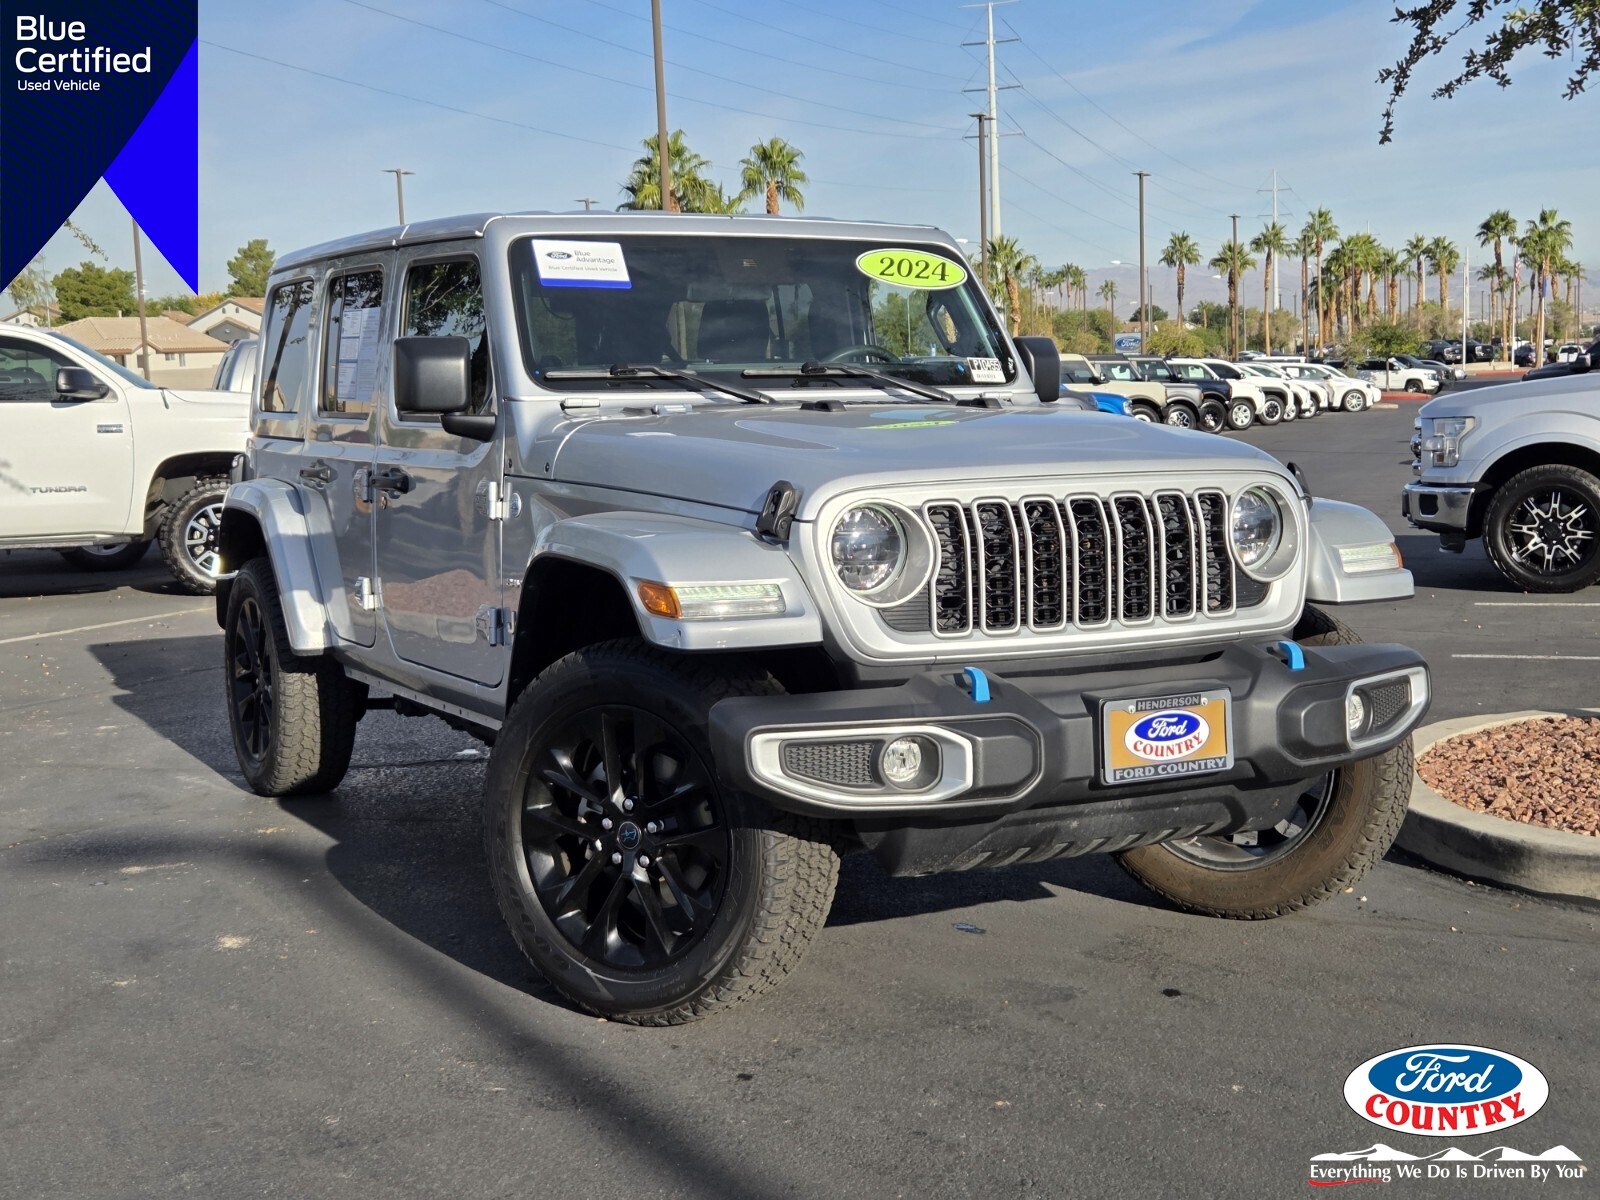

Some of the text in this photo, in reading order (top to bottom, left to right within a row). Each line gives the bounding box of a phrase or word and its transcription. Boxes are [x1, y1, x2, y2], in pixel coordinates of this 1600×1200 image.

[878, 256, 949, 281] 2024
[1137, 696, 1200, 710] HENDERSON
[1147, 717, 1188, 738] Ford
[1133, 732, 1203, 757] COUNTRY
[1115, 757, 1225, 780] FORD COUNTRY
